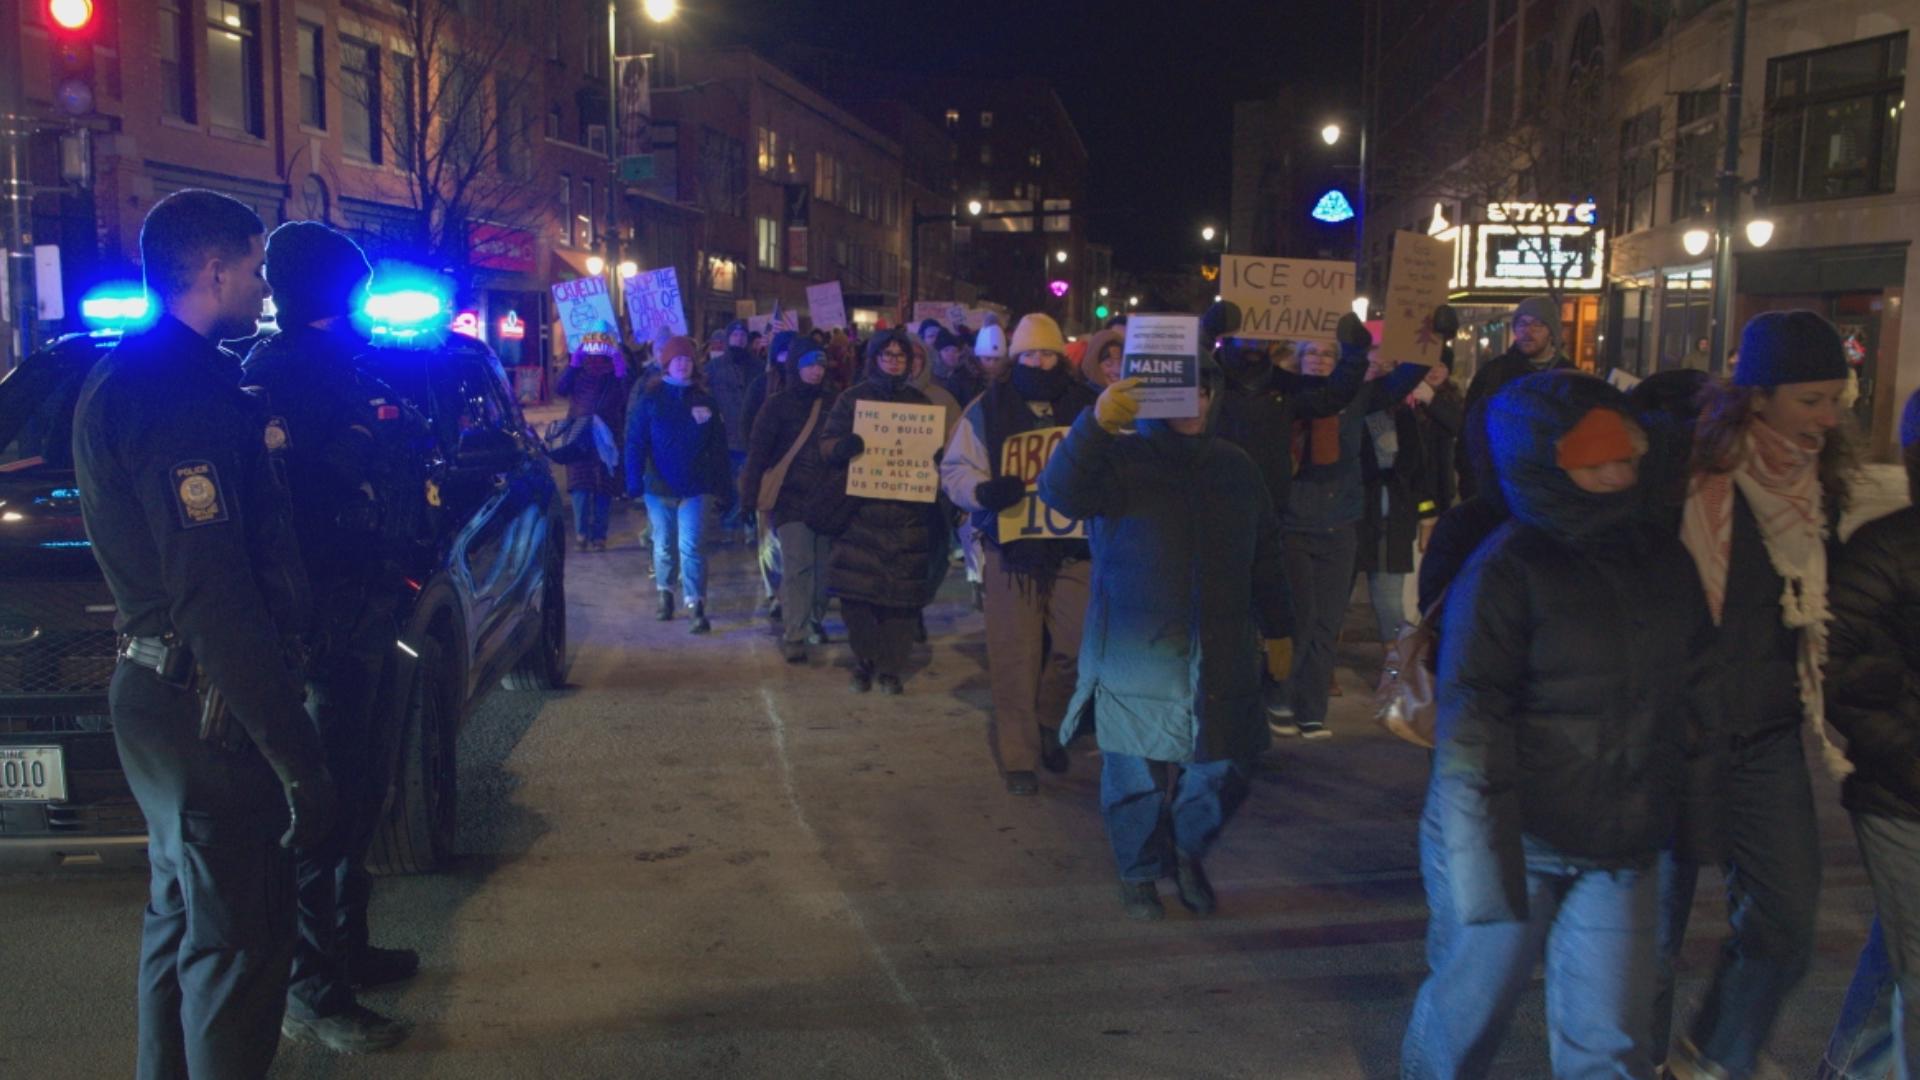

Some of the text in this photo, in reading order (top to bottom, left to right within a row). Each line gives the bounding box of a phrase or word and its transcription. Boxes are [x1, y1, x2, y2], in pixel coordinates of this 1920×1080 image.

[1487, 202, 1597, 224] STATE
[654, 267, 677, 289] THE
[1232, 259, 1354, 295] ICE OUT
[661, 287, 680, 308] OF
[1269, 293, 1292, 306] OF
[1241, 306, 1340, 334] MAINE
[1129, 359, 1184, 374] MAINE
[891, 412, 935, 421] POWER
[874, 424, 933, 434] TO BUILD
[866, 447, 903, 456] ETTER
[887, 459, 929, 468] WORLD
[177, 464, 209, 477] POLICE
[890, 470, 911, 478] ALL
[916, 471, 929, 479] OF
[851, 481, 867, 489] US
[0, 760, 45, 788] 010
